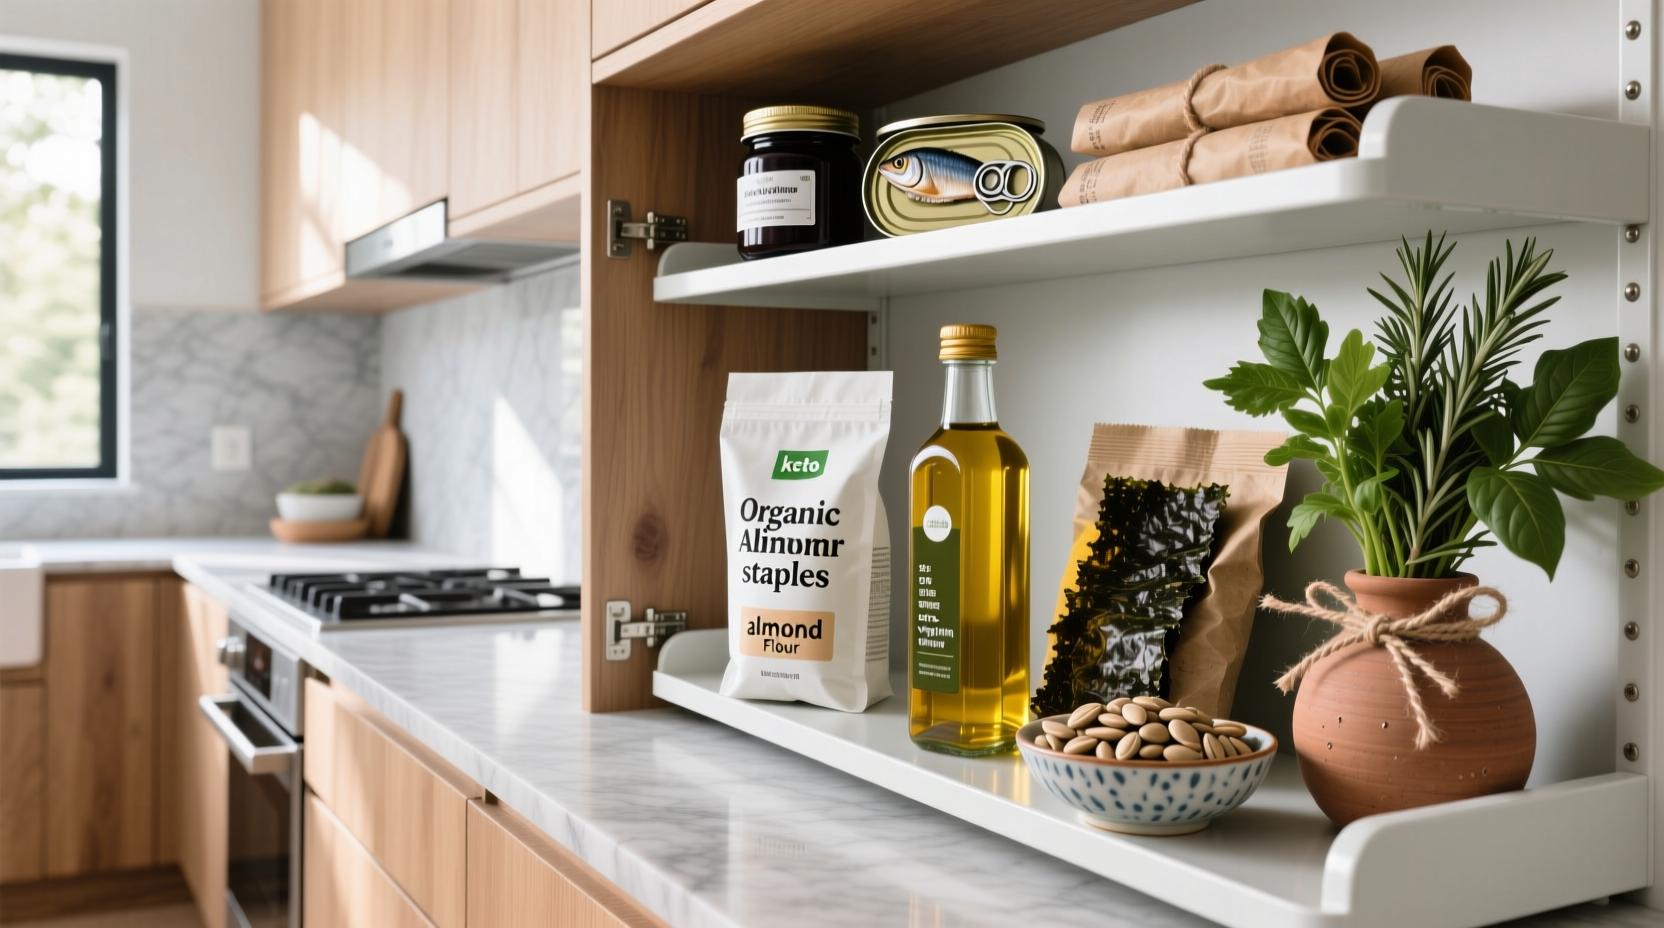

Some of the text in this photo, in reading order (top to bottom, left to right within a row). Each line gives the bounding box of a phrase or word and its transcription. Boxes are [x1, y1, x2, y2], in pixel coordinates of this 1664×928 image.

[780, 454, 820, 473] keto
[740, 497, 841, 532] Organic
[741, 560, 830, 593] staples
[747, 615, 823, 640] almond
[763, 638, 800, 654] Flour
